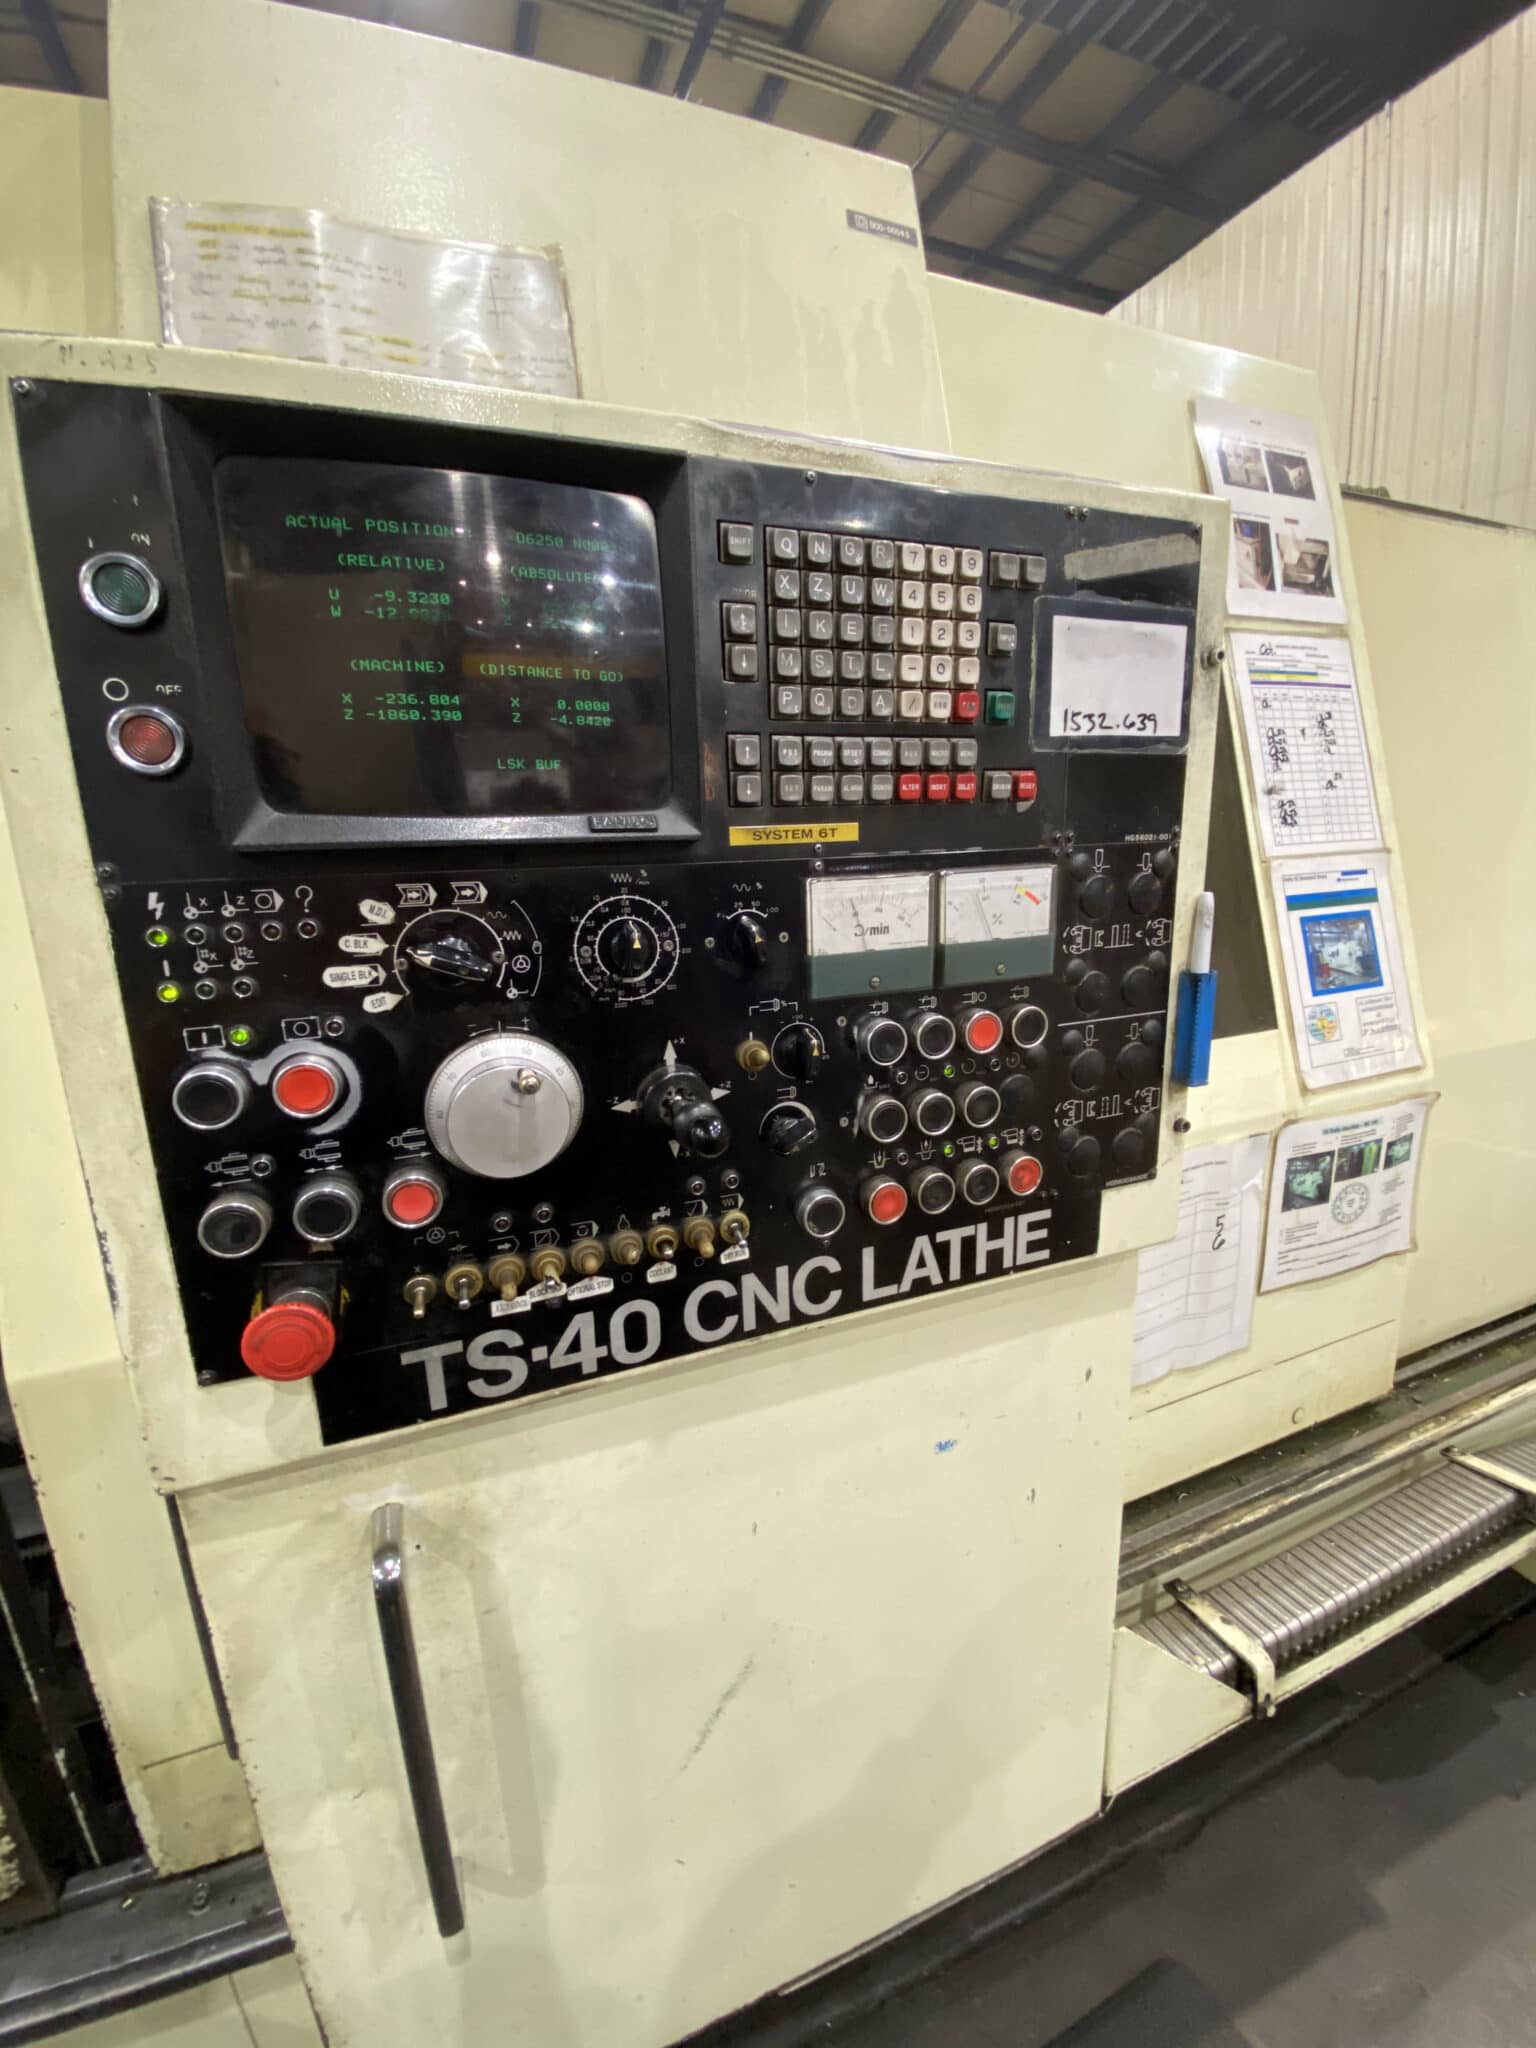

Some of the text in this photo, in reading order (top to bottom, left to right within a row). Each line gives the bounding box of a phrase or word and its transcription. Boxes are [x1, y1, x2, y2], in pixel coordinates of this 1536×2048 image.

[285, 515, 454, 537] ACTUAL POSITION
[814, 541, 825, 555] N
[845, 542, 855, 556] G
[876, 545, 887, 559] R
[338, 552, 446, 571] (RELATIVE)
[909, 551, 919, 564] 7
[939, 554, 948, 567] 8
[967, 557, 977, 570] 9
[780, 575, 790, 590] X
[813, 577, 823, 592] Z
[845, 581, 856, 595] U
[328, 587, 451, 605] U -9.3230
[874, 583, 888, 597] W
[908, 589, 917, 602] 4
[937, 591, 947, 604] 5
[966, 593, 976, 606] 6
[330, 605, 342, 617] W
[816, 619, 826, 633] K
[847, 621, 857, 635] E
[878, 624, 888, 638] F
[937, 628, 946, 641] 2
[966, 629, 974, 642] 3
[350, 659, 445, 673] (MACHINE)
[781, 653, 793, 667] M
[815, 654, 825, 669] S
[848, 656, 856, 670] T
[876, 658, 886, 672] L
[479, 663, 623, 682] (DISTANCE TO GO)
[341, 693, 352, 705] X
[510, 697, 610, 712] X 0.0000
[782, 691, 793, 705] P
[814, 692, 825, 707] Q
[848, 696, 857, 709] D
[876, 695, 886, 707] A
[343, 708, 463, 722] Z -1860.390
[512, 713, 521, 724] Z
[1063, 708, 1158, 735] 1532.639
[497, 758, 562, 771] LSK BUF
[752, 827, 838, 841] SYSTEM 6T
[353, 939, 369, 950] BLK
[329, 971, 356, 983] SINGLE
[683, 1255, 841, 1344] CNC
[862, 1208, 1053, 1303] LATHE
